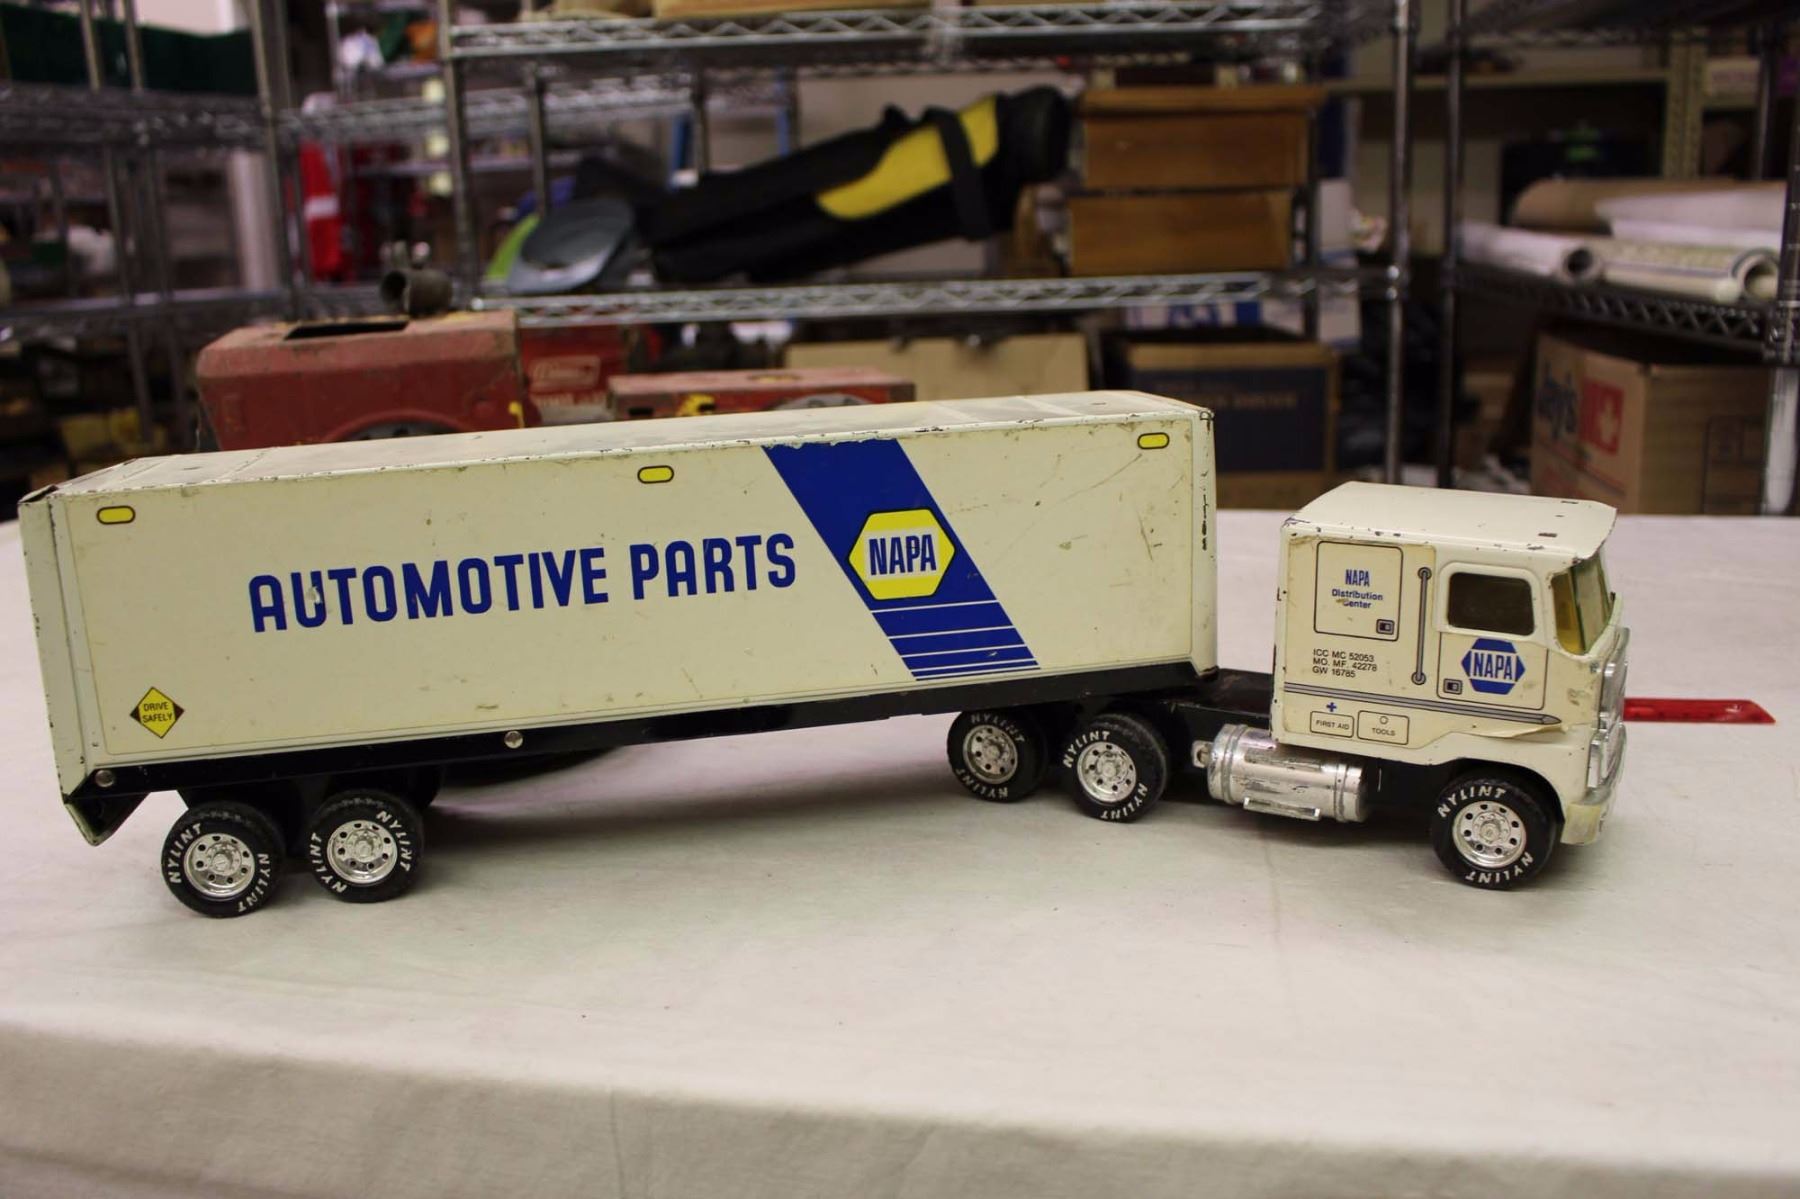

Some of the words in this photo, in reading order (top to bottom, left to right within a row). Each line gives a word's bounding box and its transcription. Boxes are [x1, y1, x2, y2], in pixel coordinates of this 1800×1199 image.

[868, 534, 937, 576] NAPA
[249, 547, 609, 633] AUTOMOTIVE
[629, 533, 796, 600] PARTS
[1345, 569, 1370, 587] NAPA
[1331, 588, 1383, 601] Distribution
[1312, 665, 1328, 674] GW
[1313, 648, 1329, 658] ICC
[1332, 651, 1346, 659] MC
[1349, 652, 1375, 662] 52053
[1352, 662, 1378, 672] 42278
[1473, 652, 1512, 680] NAPA
[142, 713, 173, 723] SAFELY
[143, 702, 169, 711] DRIVE
[971, 713, 1025, 743] NYLINT
[1316, 719, 1336, 728] FIRST
[1371, 727, 1396, 736] TOOLS
[1062, 730, 1111, 769] NYLINT
[955, 767, 1009, 799] NYLINT
[1101, 783, 1149, 820] NYLINT
[1437, 785, 1507, 818] NYLINT
[168, 823, 202, 883] NYLINT
[376, 810, 412, 872] NYLINT
[310, 832, 348, 893] NYLINT
[1465, 851, 1534, 884] NYLINT
[236, 853, 270, 912] NYLINT
